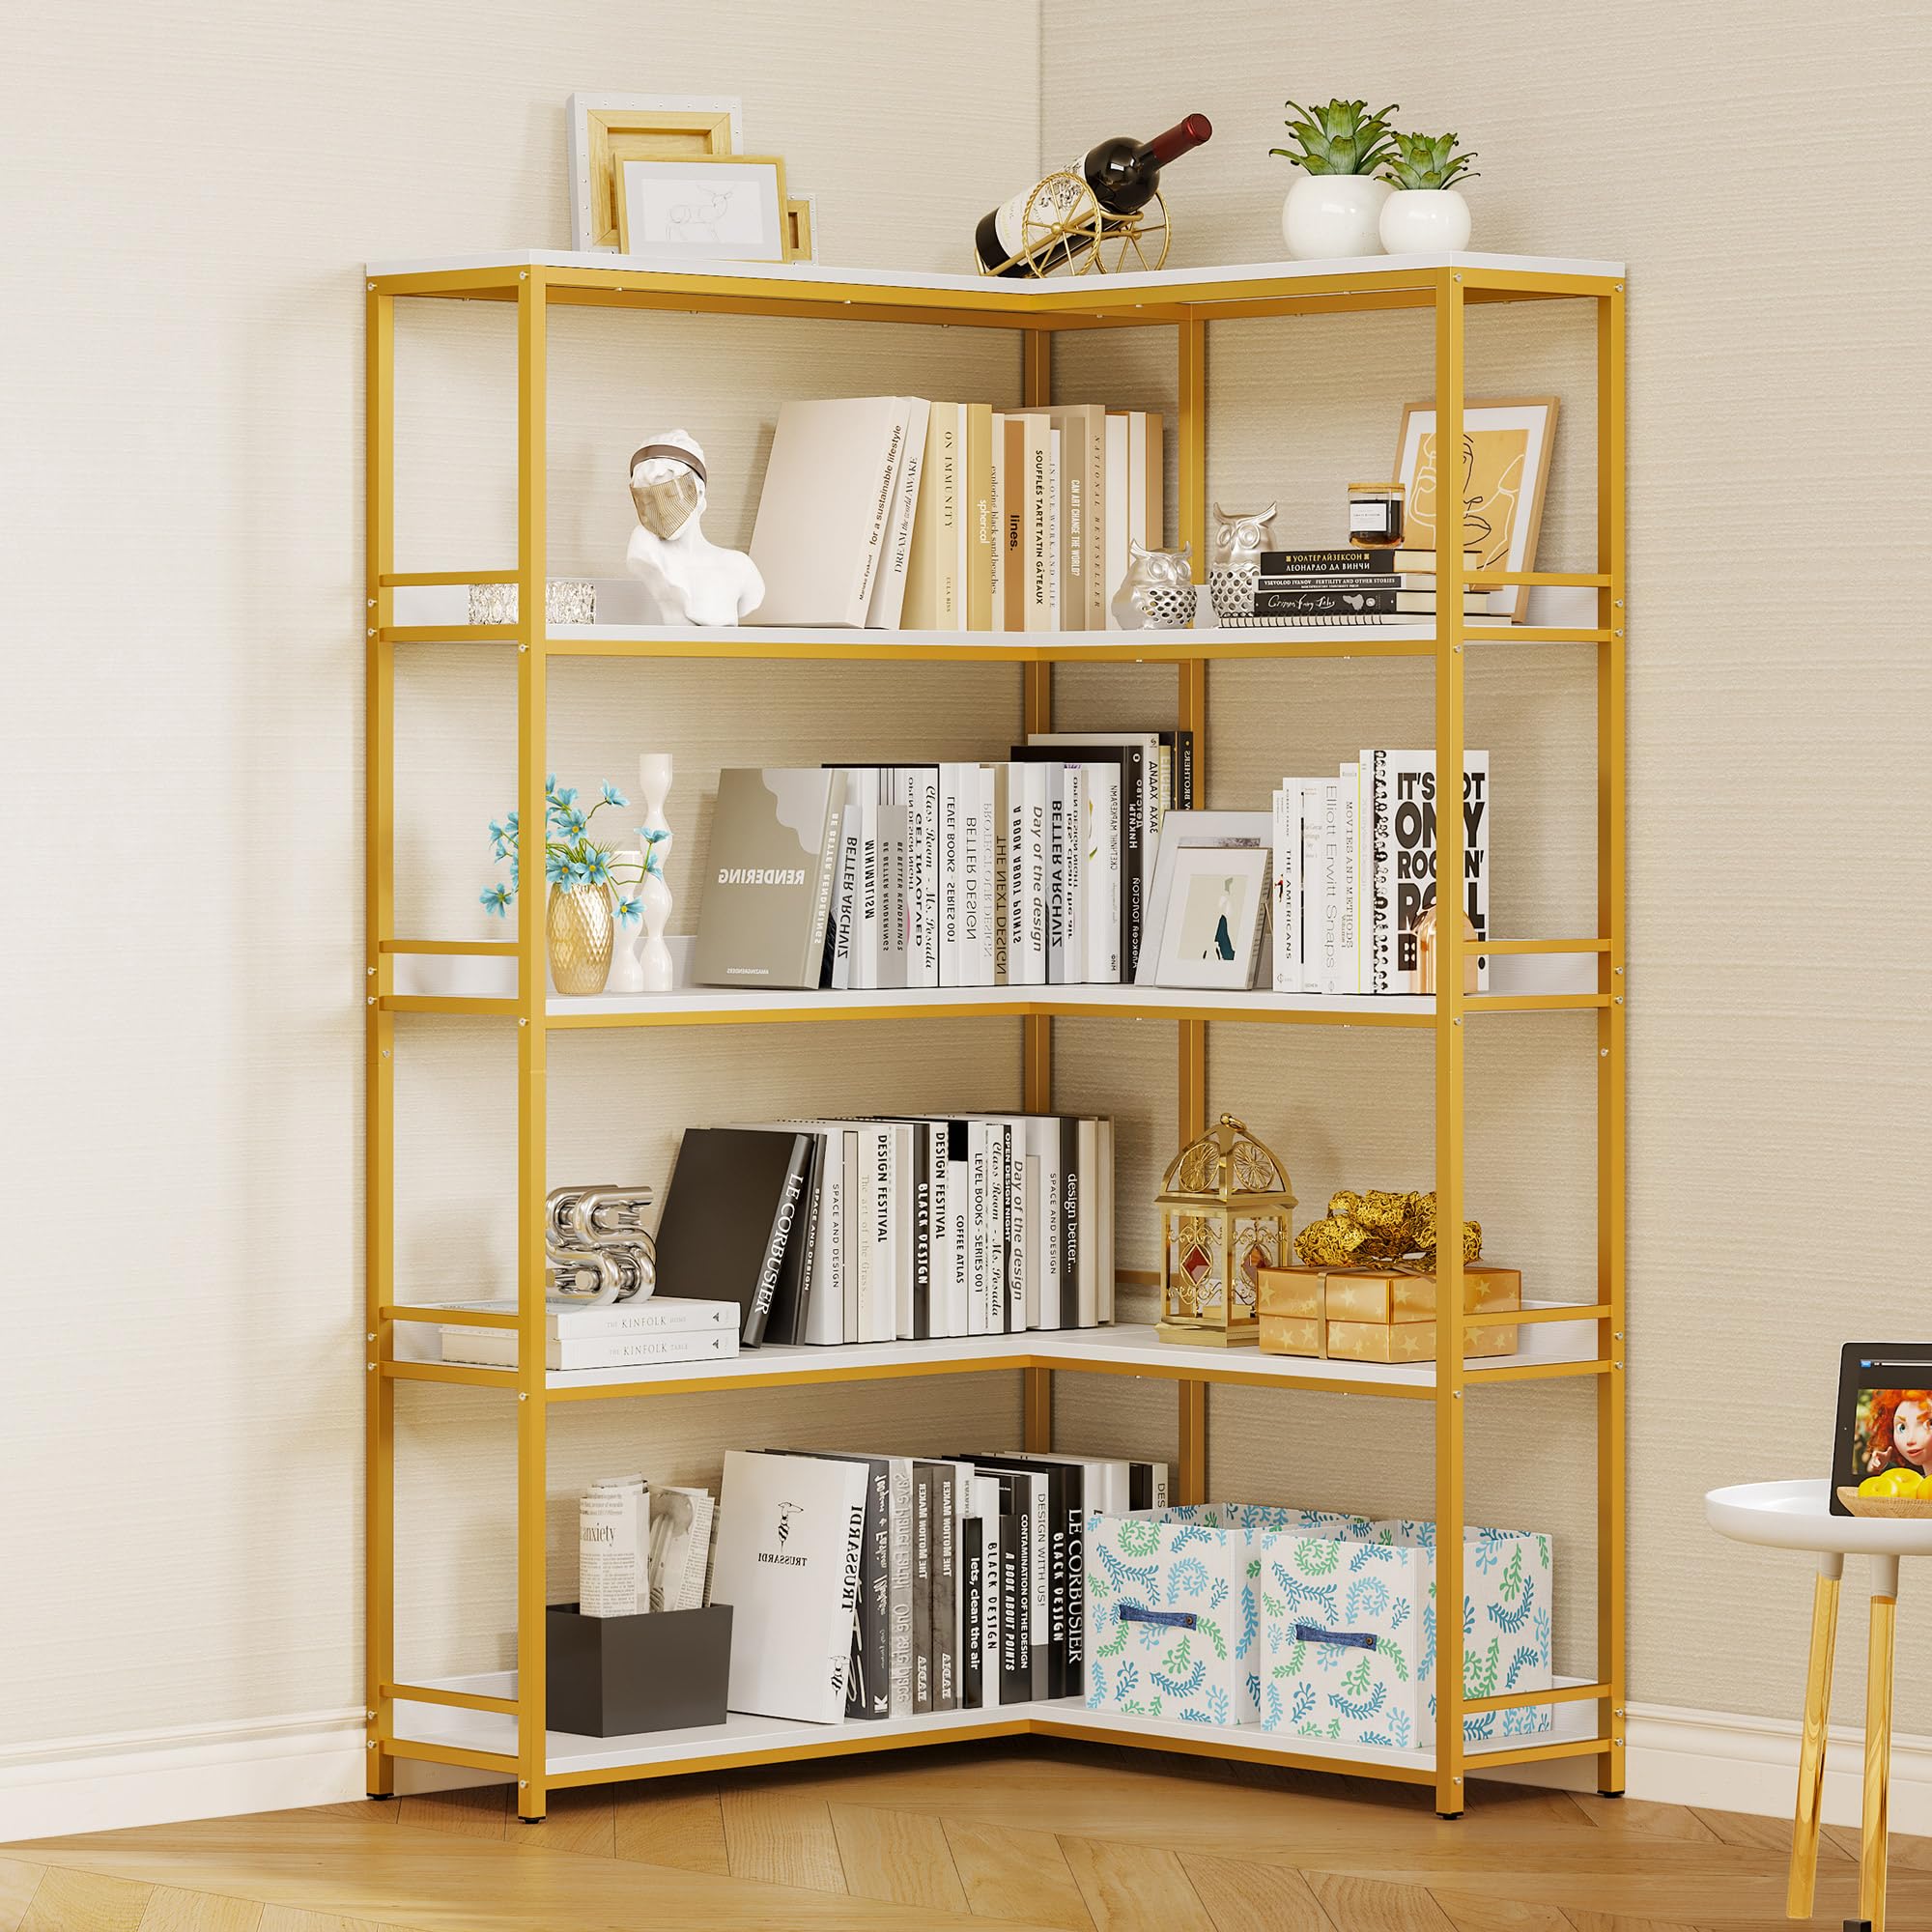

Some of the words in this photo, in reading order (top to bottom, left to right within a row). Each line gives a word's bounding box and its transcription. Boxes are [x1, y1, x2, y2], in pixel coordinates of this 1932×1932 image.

[945, 431, 952, 448] ON
[869, 530, 878, 545] for
[876, 464, 893, 520] sustainable
[887, 425, 901, 463] lifestyle
[1036, 450, 1045, 495] SOUFFLÉS
[1071, 479, 1080, 495] CAN
[895, 532, 907, 572] DREAM
[906, 457, 918, 495] AWAKE
[1036, 498, 1045, 526] TARTE
[1071, 496, 1080, 508] ART
[977, 499, 990, 544] spherical
[1009, 514, 1020, 551] lines.
[1071, 509, 1080, 535] CHANGE
[1036, 529, 1045, 557] TATIN
[1071, 537, 1080, 548] THE
[1321, 553, 1362, 562] АЙЗЕКСОН
[1071, 550, 1080, 576] WORLD?
[1329, 563, 1340, 572] ДА
[1036, 560, 1045, 605] GÂTEAUX
[925, 785, 936, 822] Class
[1398, 773, 1435, 800] IT'S
[1031, 807, 1042, 838] Day
[1326, 785, 1337, 835] Elliott
[1395, 802, 1485, 849] ONY
[925, 829, 936, 867] Room
[1034, 843, 1043, 859] of
[1034, 865, 1043, 892] the
[1326, 843, 1337, 897] Erwitt
[925, 887, 936, 912] Ms.
[1031, 896, 1043, 952] design
[1322, 905, 1337, 969] Snaps
[925, 919, 936, 968] Posada
[878, 1135, 888, 1181] DESIGN
[936, 1132, 945, 1179] DESIGN
[992, 1142, 1002, 1178] Class
[785, 1173, 804, 1200] LE
[1011, 1161, 1023, 1190] Day
[878, 1186, 888, 1242] FESTIVAL
[918, 1182, 927, 1227] BLACK
[936, 1184, 945, 1239] FESTIVAL
[992, 1182, 1002, 1220] Room
[1014, 1197, 1024, 1212] of
[1064, 1174, 1078, 1219] design
[1014, 1215, 1023, 1243] the
[1067, 1222, 1078, 1273] better...
[754, 1203, 796, 1315] CORBUSIER
[918, 1234, 927, 1285] DESIGN
[992, 1238, 1002, 1264] Ms.
[804, 1251, 812, 1291] DESIGN
[1011, 1248, 1023, 1300] design
[992, 1269, 1002, 1316] Posada
[622, 1316, 667, 1328] KINFOLK
[624, 1343, 667, 1356] KINFOLK
[582, 1522, 616, 1547] anxiety
[1068, 1509, 1083, 1534] LE
[970, 1557, 980, 1586] lets,
[987, 1543, 998, 1588] BLACK
[1053, 1532, 1064, 1579] BLACK
[1005, 1564, 1014, 1591] BOOK
[970, 1589, 980, 1624] clean
[1005, 1595, 1014, 1629] ABOUT
[1021, 1598, 1028, 1610] OF
[1053, 1588, 1064, 1641] DESIGN
[1068, 1539, 1083, 1663] CORBUSIER
[970, 1627, 980, 1651] the
[987, 1597, 998, 1650] DESIGN
[970, 1653, 980, 1669] air
[1005, 1634, 1014, 1671] POINTS
